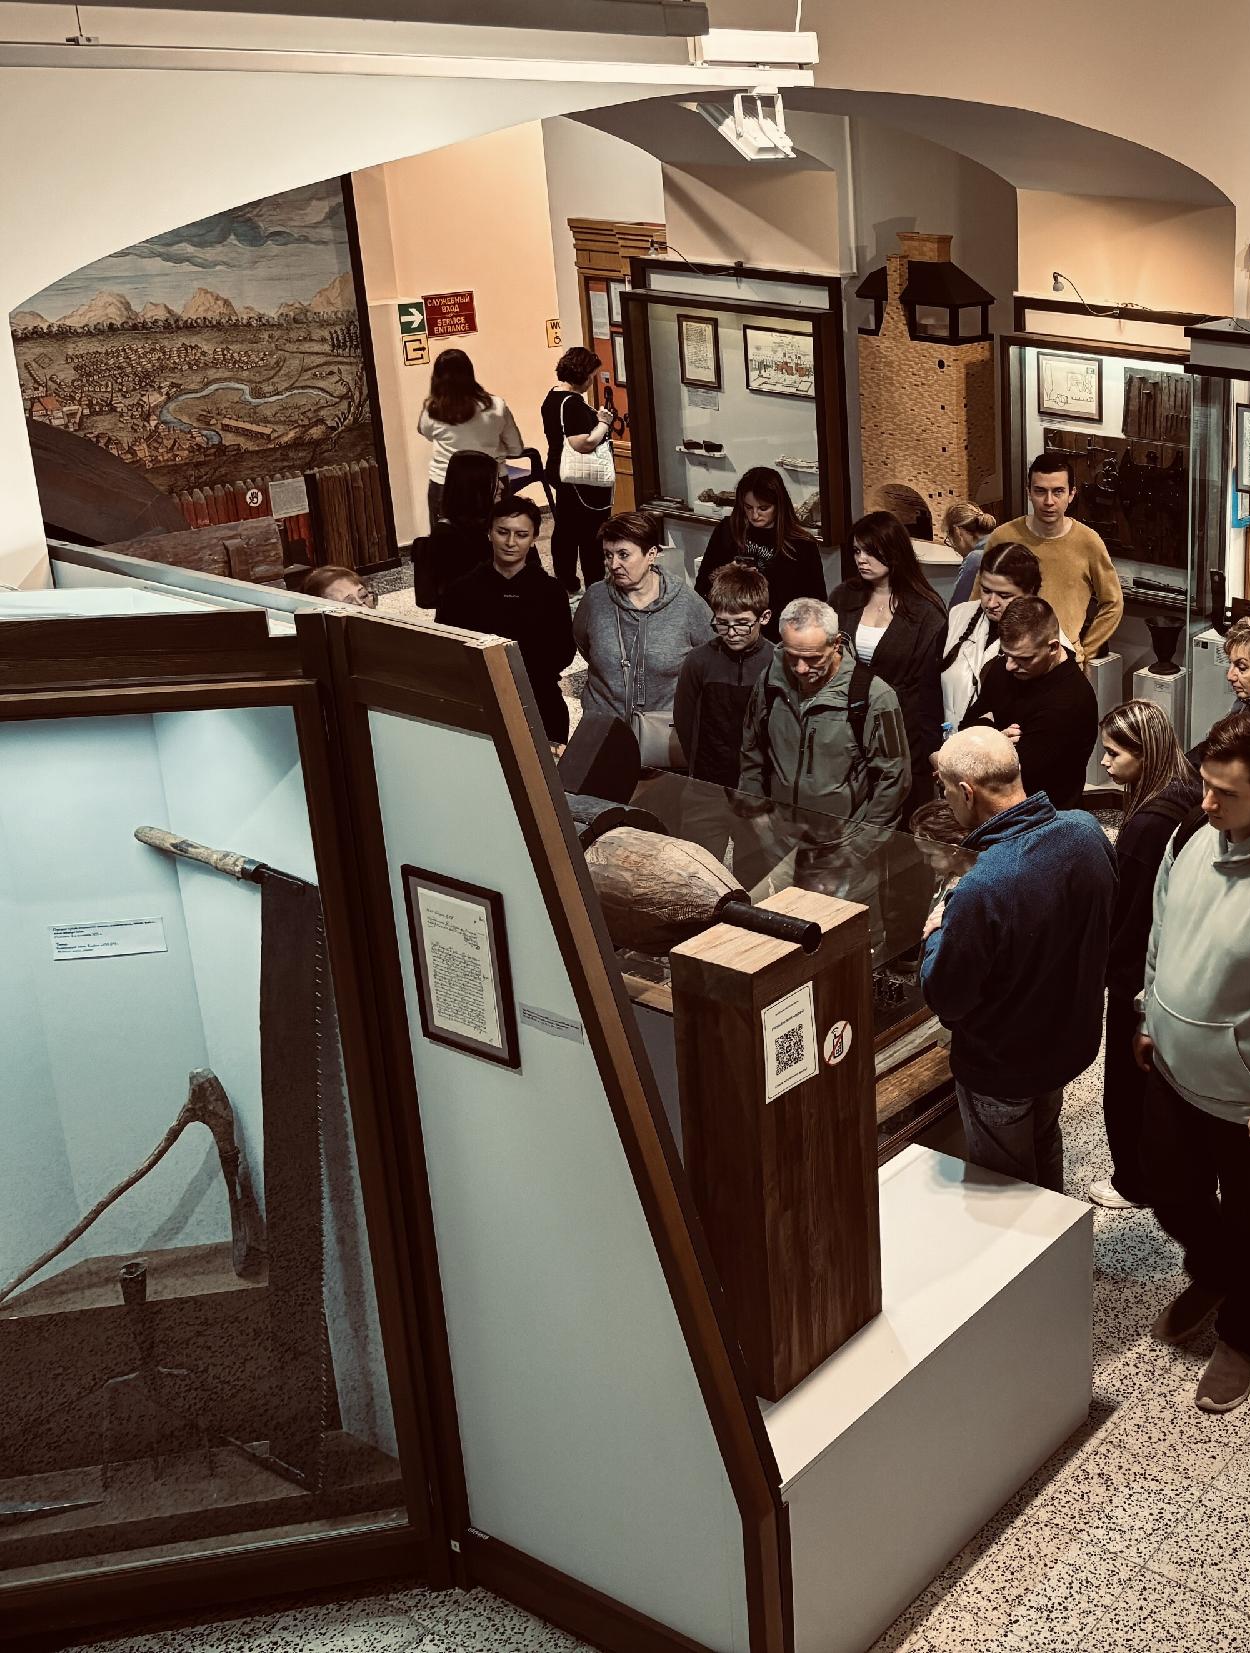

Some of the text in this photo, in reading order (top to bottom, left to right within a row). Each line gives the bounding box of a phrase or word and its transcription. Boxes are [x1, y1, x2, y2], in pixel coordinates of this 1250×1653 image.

[427, 294, 470, 306] СЛУЖЕБНЫЙ
[441, 304, 460, 313] ВХОД
[437, 316, 466, 327] SERVICE
[434, 324, 470, 334] ENTRANCE
